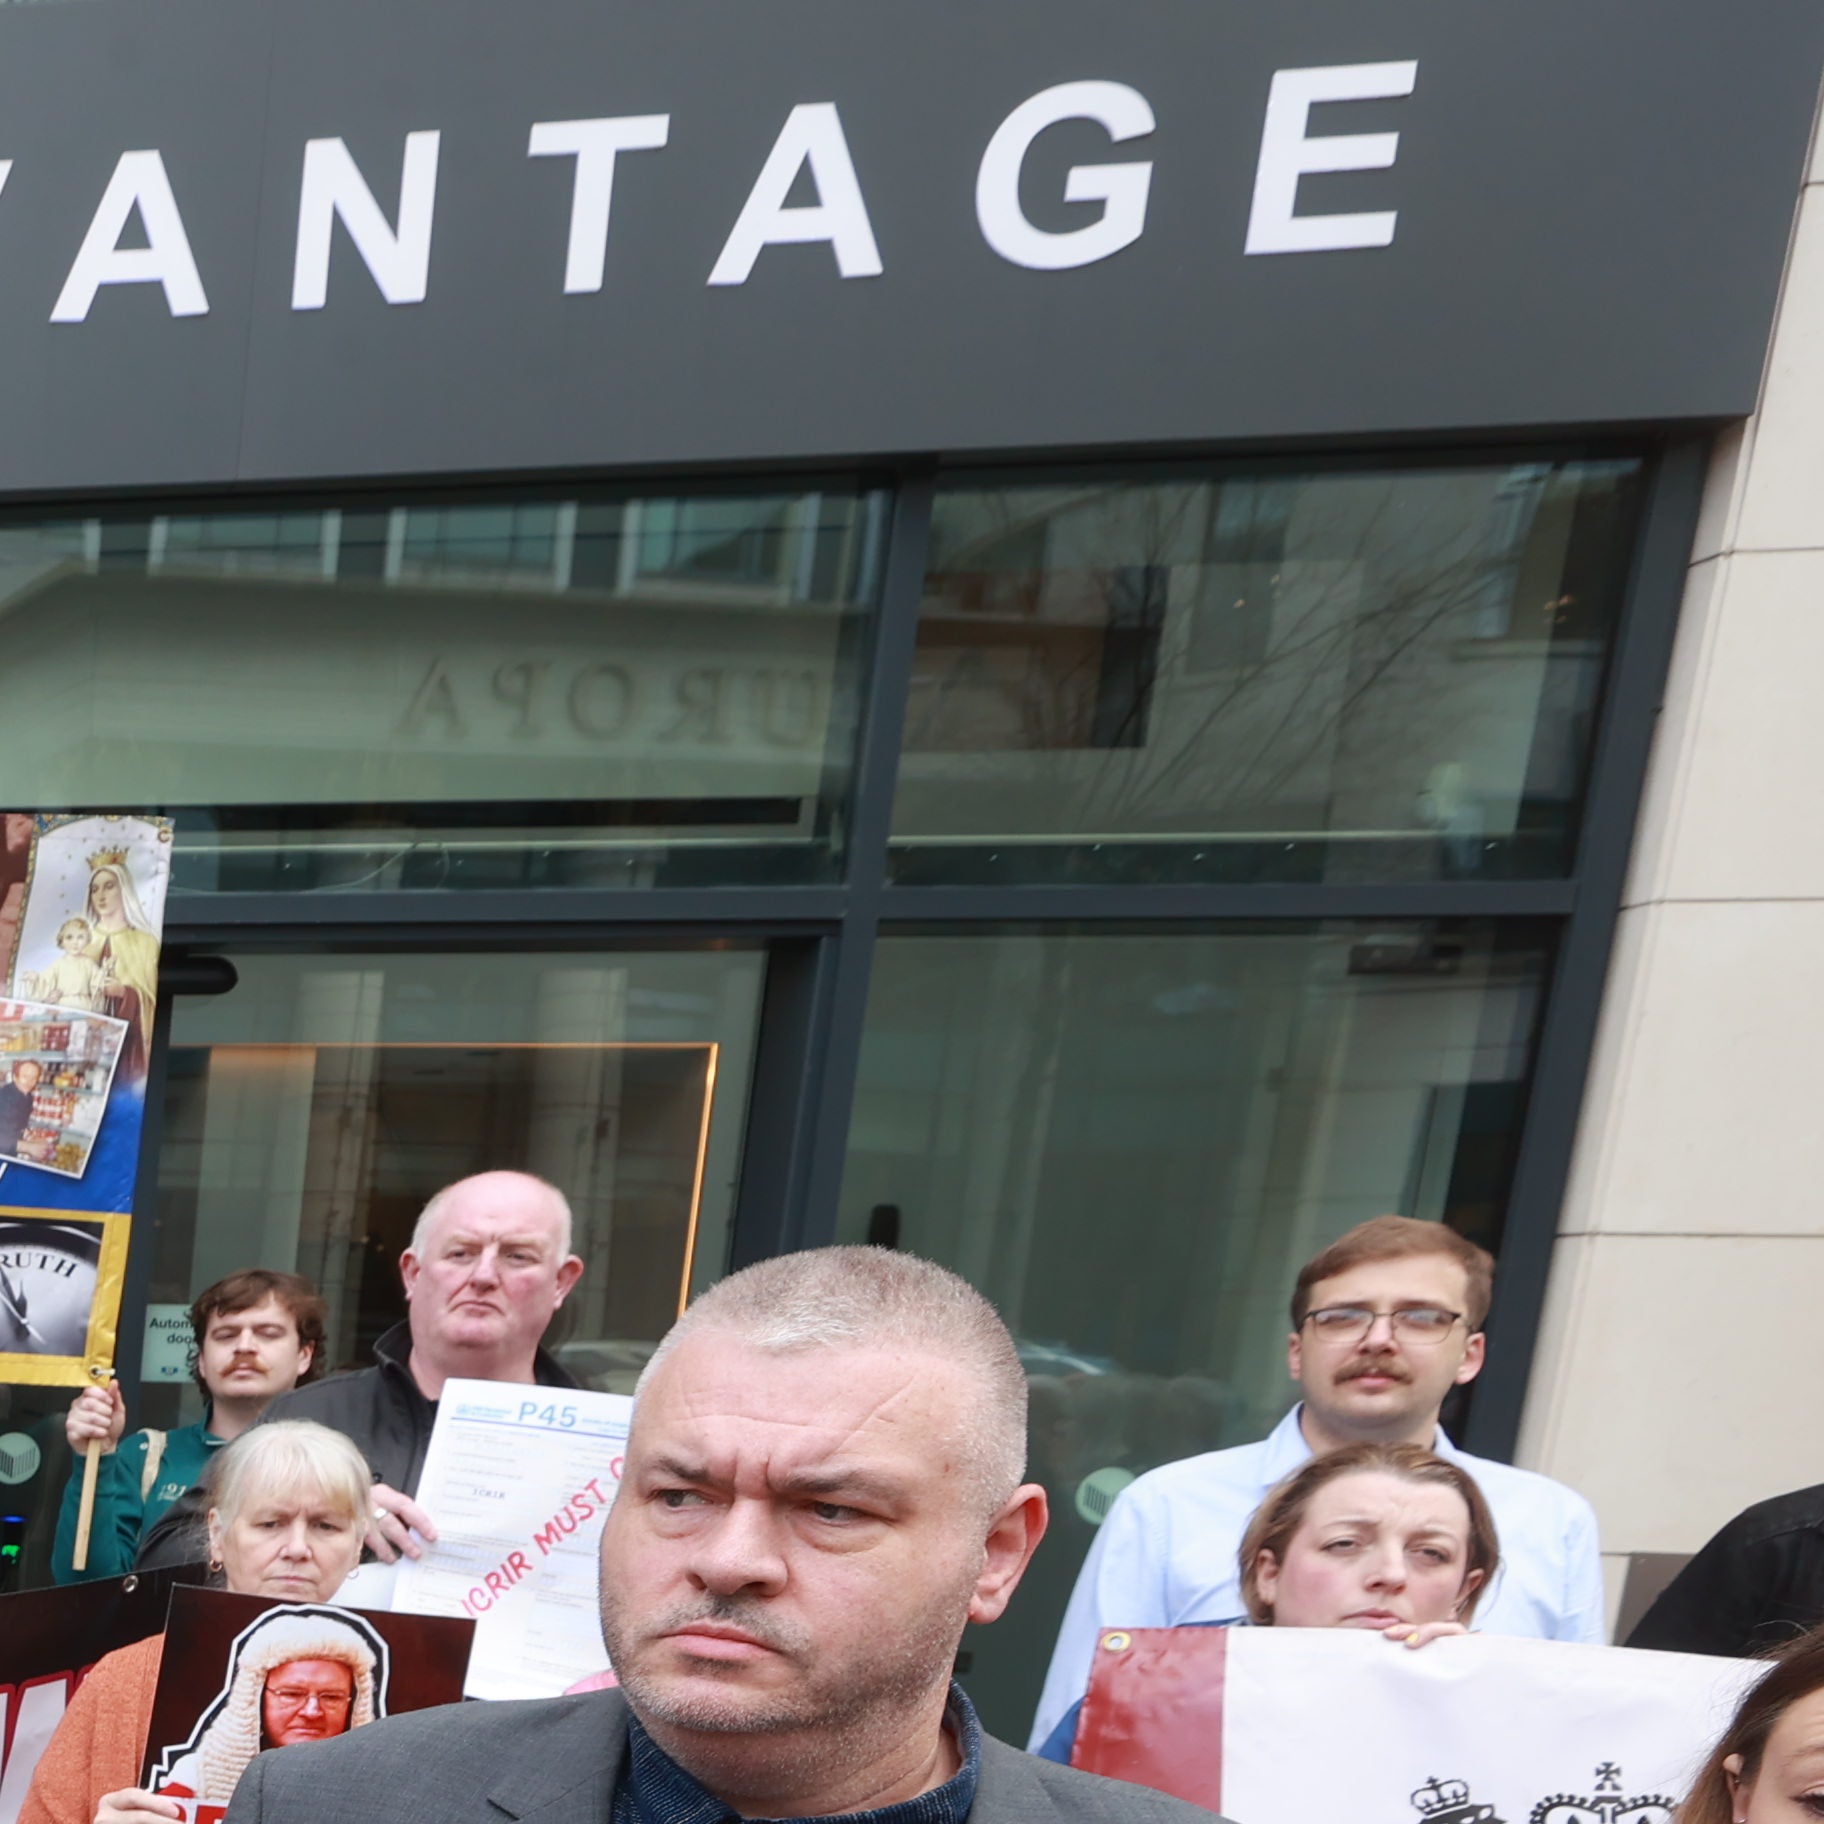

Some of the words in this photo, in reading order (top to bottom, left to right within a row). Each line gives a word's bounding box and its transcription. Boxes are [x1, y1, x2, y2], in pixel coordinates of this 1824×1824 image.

[149, 1318, 194, 1328] Autom
[167, 1334, 194, 1344] doo
[518, 1402, 577, 1428] P45
[461, 1551, 534, 1616] ICRIR
[533, 1478, 606, 1555] MUST
